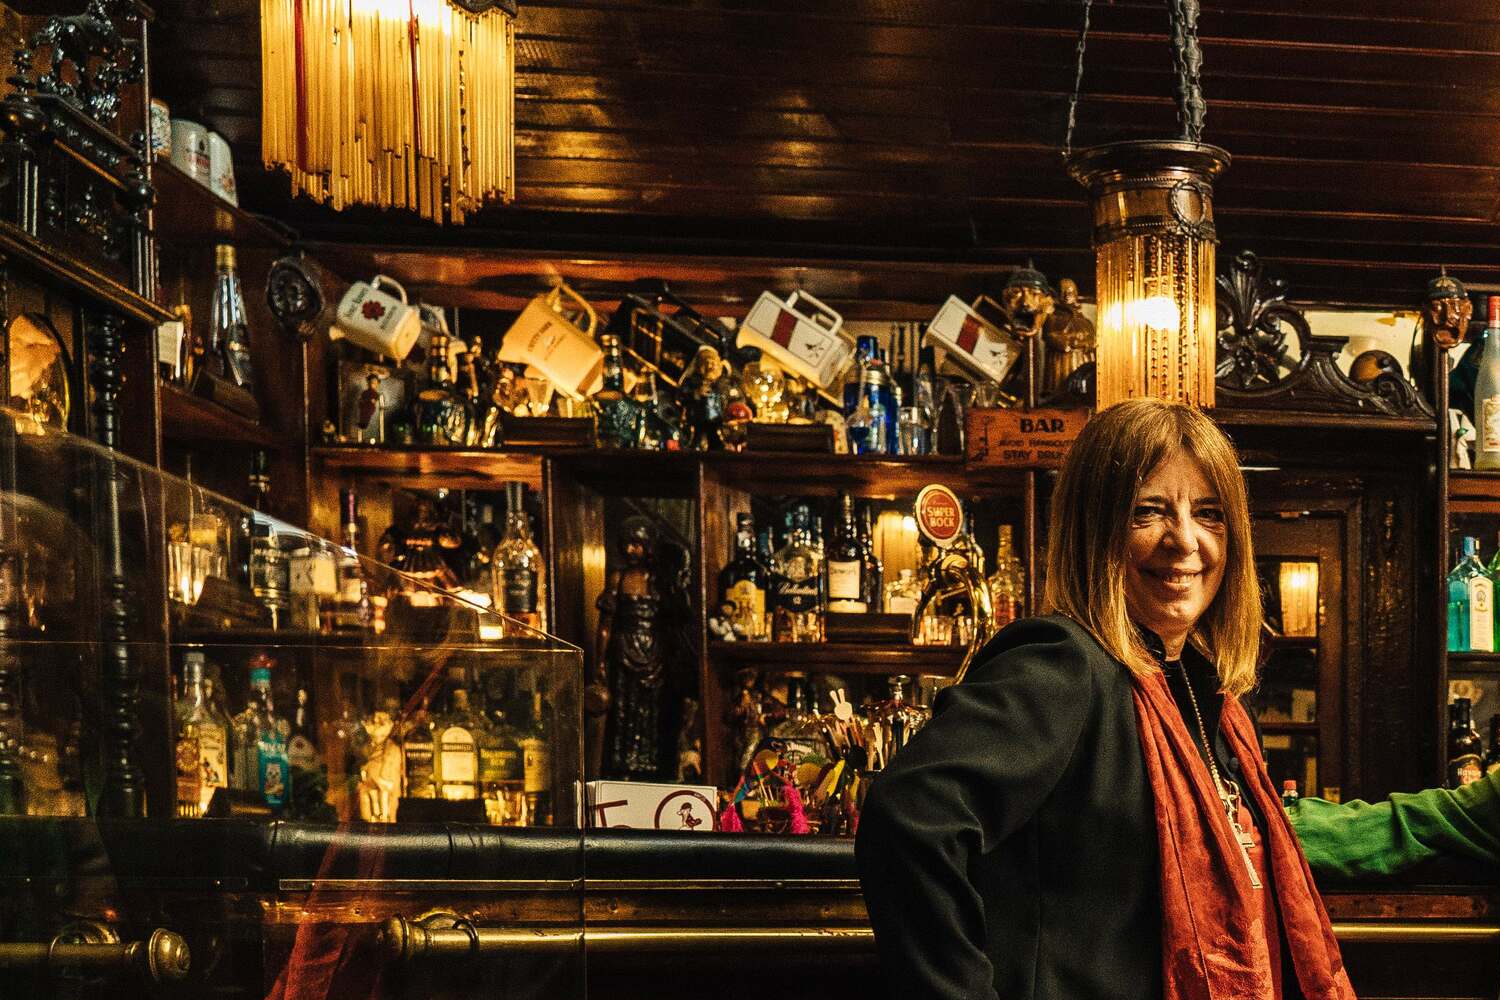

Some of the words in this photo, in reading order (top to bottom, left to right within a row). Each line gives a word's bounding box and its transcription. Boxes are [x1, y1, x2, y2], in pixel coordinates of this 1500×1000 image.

[1020, 418, 1065, 433] BAR
[1003, 450, 1031, 459] STAY
[926, 506, 954, 517] SUPER
